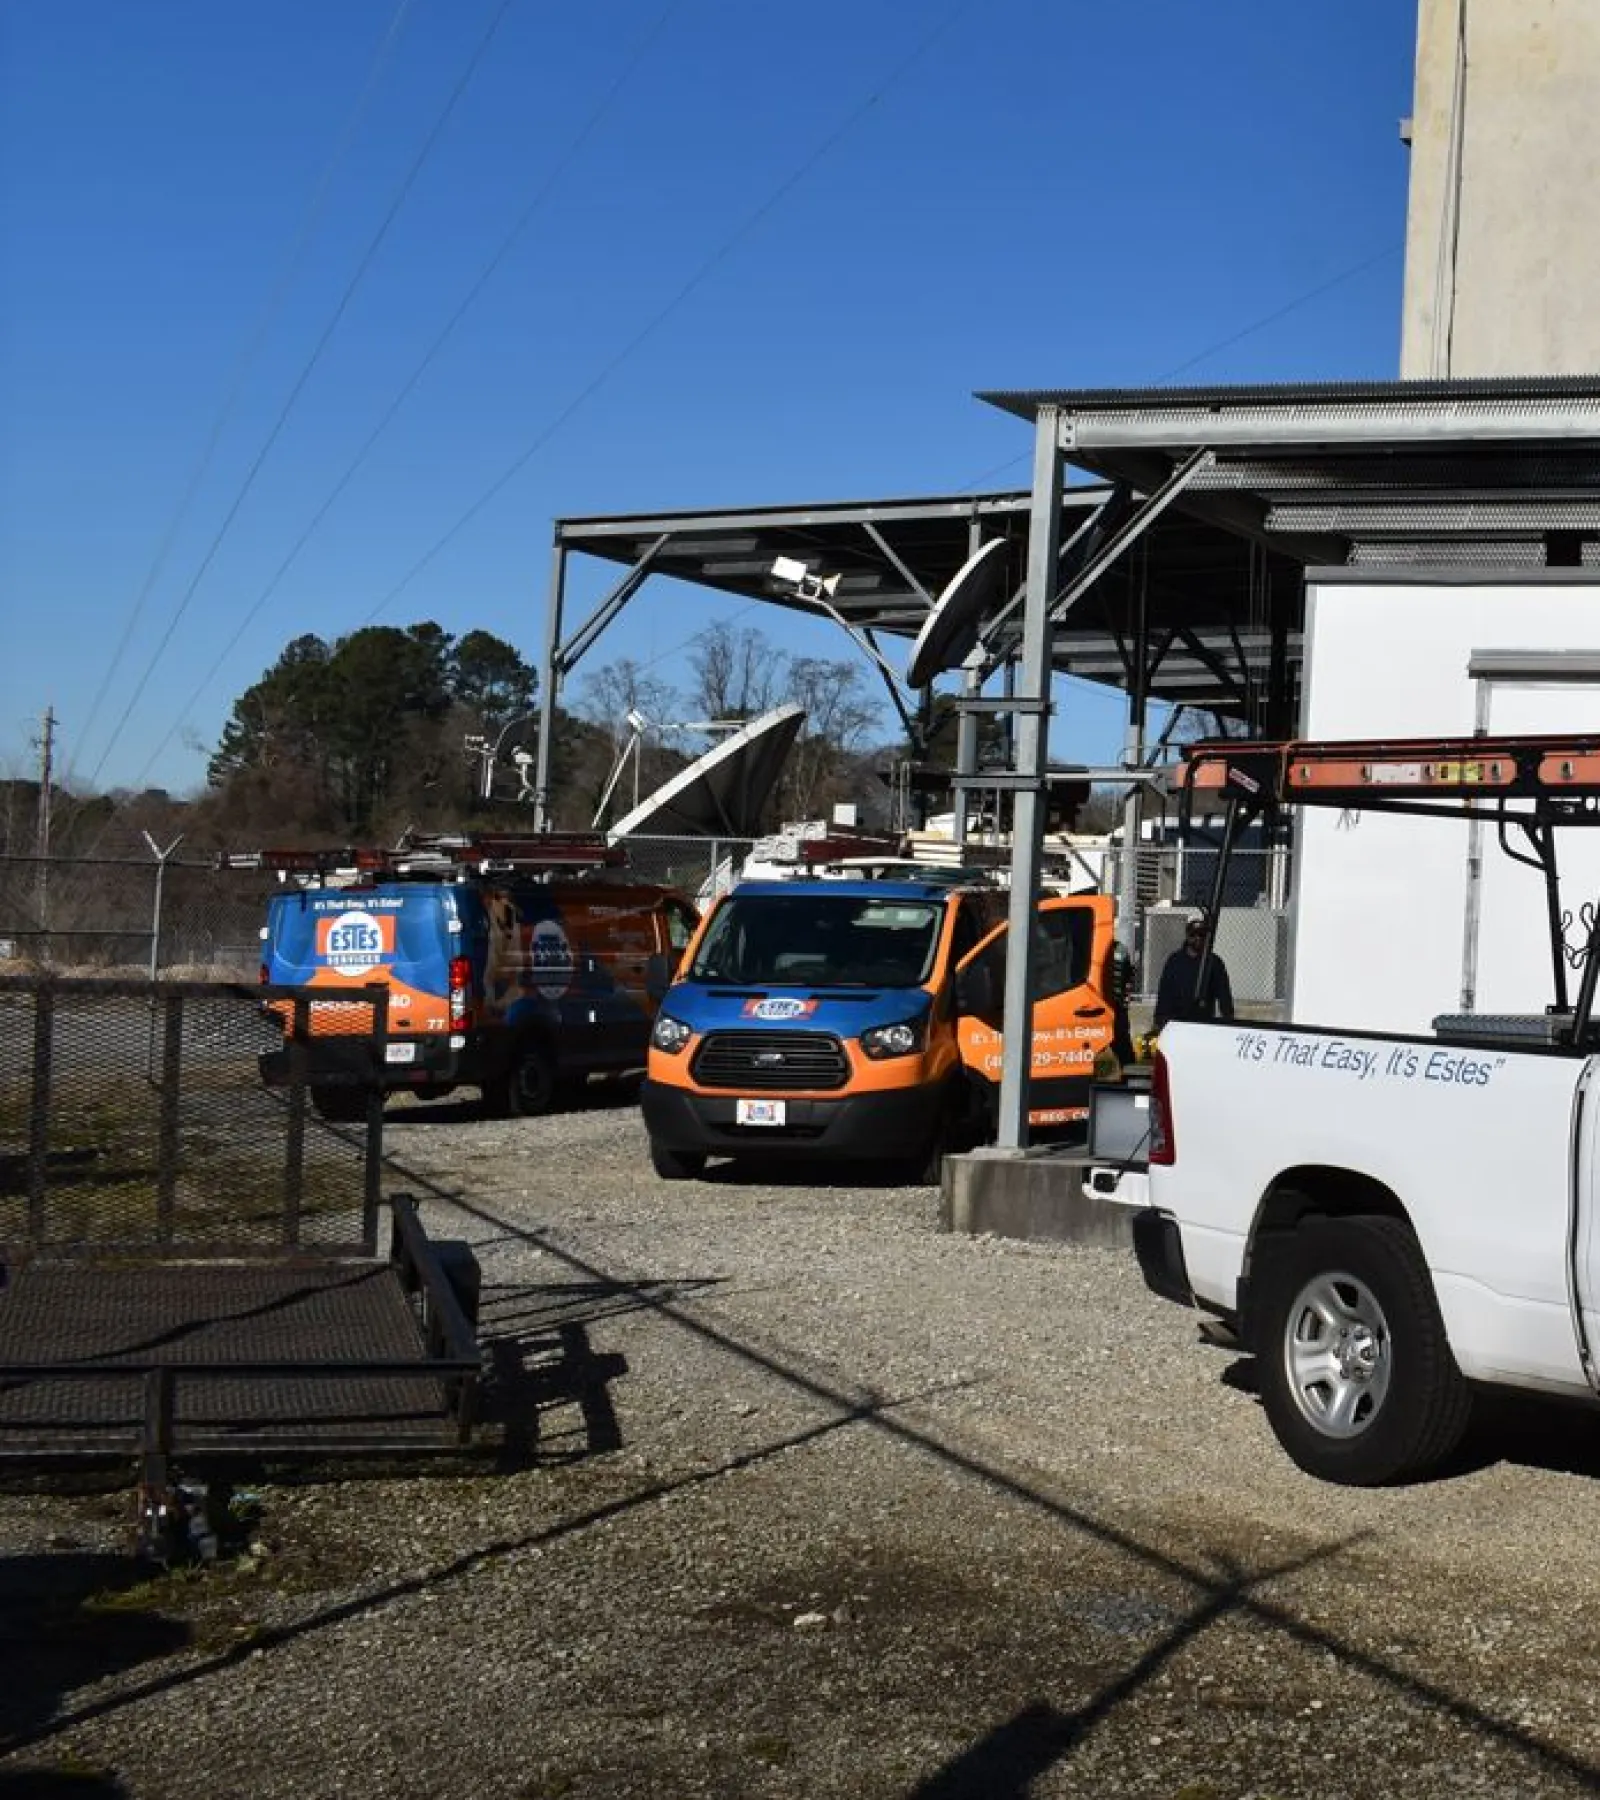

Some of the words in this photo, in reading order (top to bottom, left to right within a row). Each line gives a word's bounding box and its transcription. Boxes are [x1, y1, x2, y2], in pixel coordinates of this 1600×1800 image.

[331, 924, 379, 951] ESTES
[427, 1018, 445, 1030] 77
[1273, 1036, 1319, 1068] That
[1321, 1041, 1377, 1080] Easy,
[1386, 1047, 1419, 1078] It's
